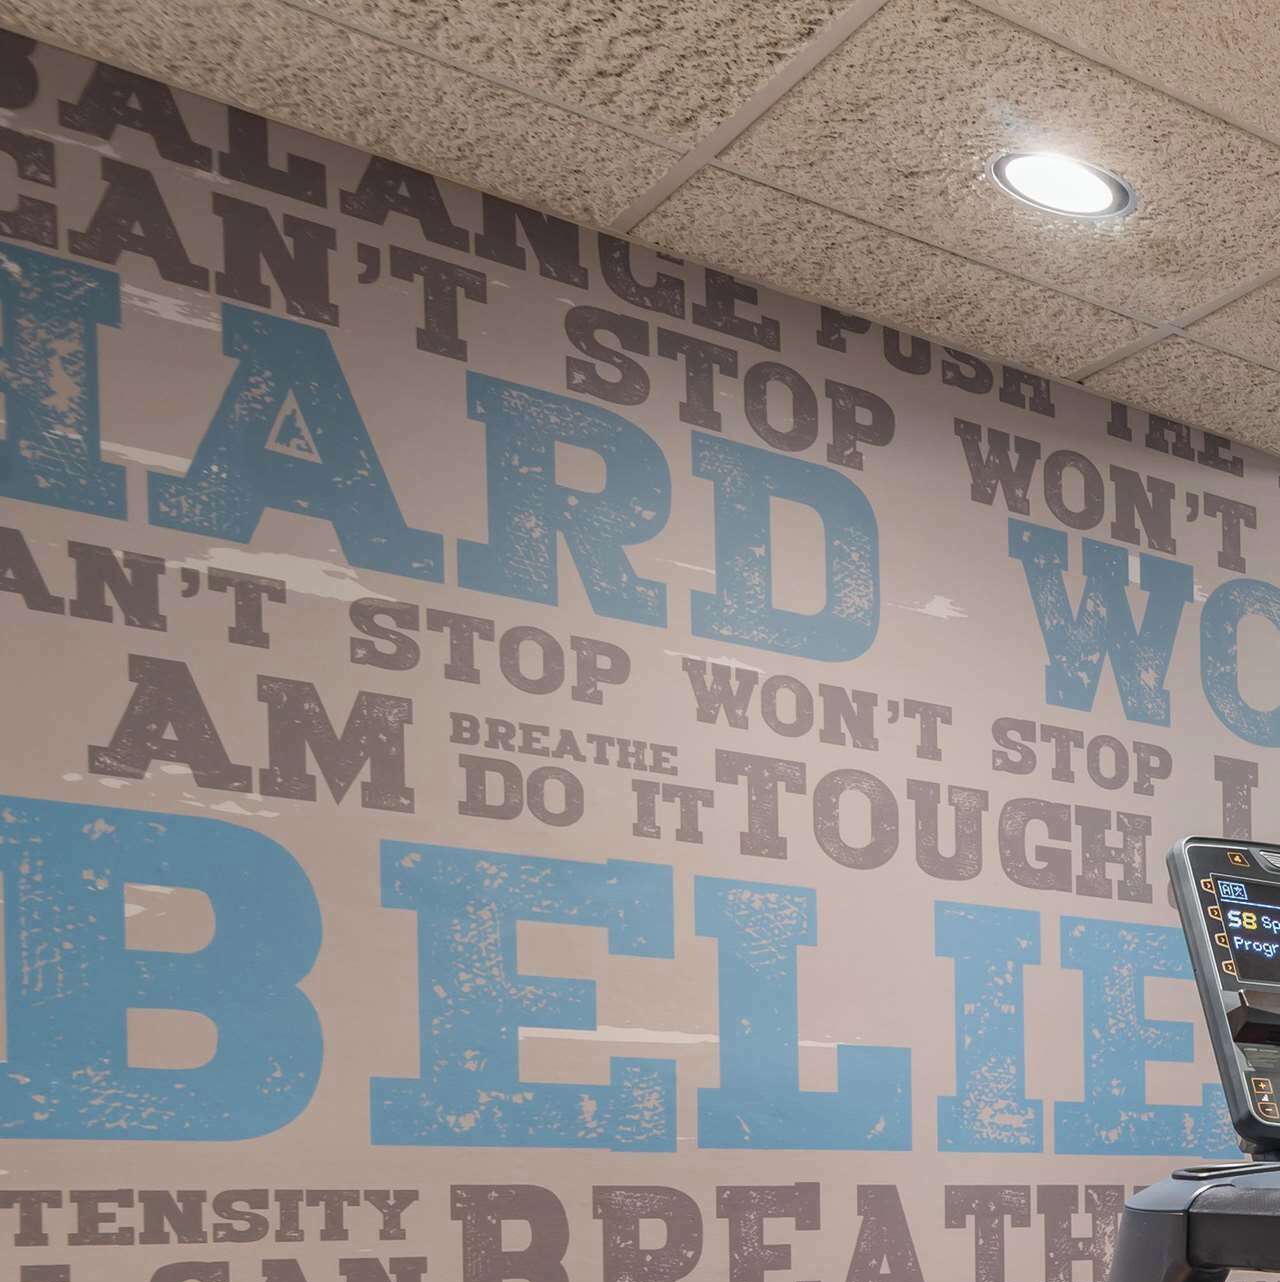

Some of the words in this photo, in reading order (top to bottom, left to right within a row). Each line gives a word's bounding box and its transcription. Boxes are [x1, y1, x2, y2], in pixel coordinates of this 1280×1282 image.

[564, 306, 896, 471] STOP
[953, 416, 1258, 574] WON'T
[87, 653, 415, 813] AM
[350, 597, 632, 706] STOP
[682, 656, 952, 761] WON'T
[992, 716, 1173, 797] STOP
[450, 711, 679, 776] BREATHE
[459, 753, 585, 828] DO
[631, 778, 715, 845] IT
[715, 747, 1154, 905] TOUGH
